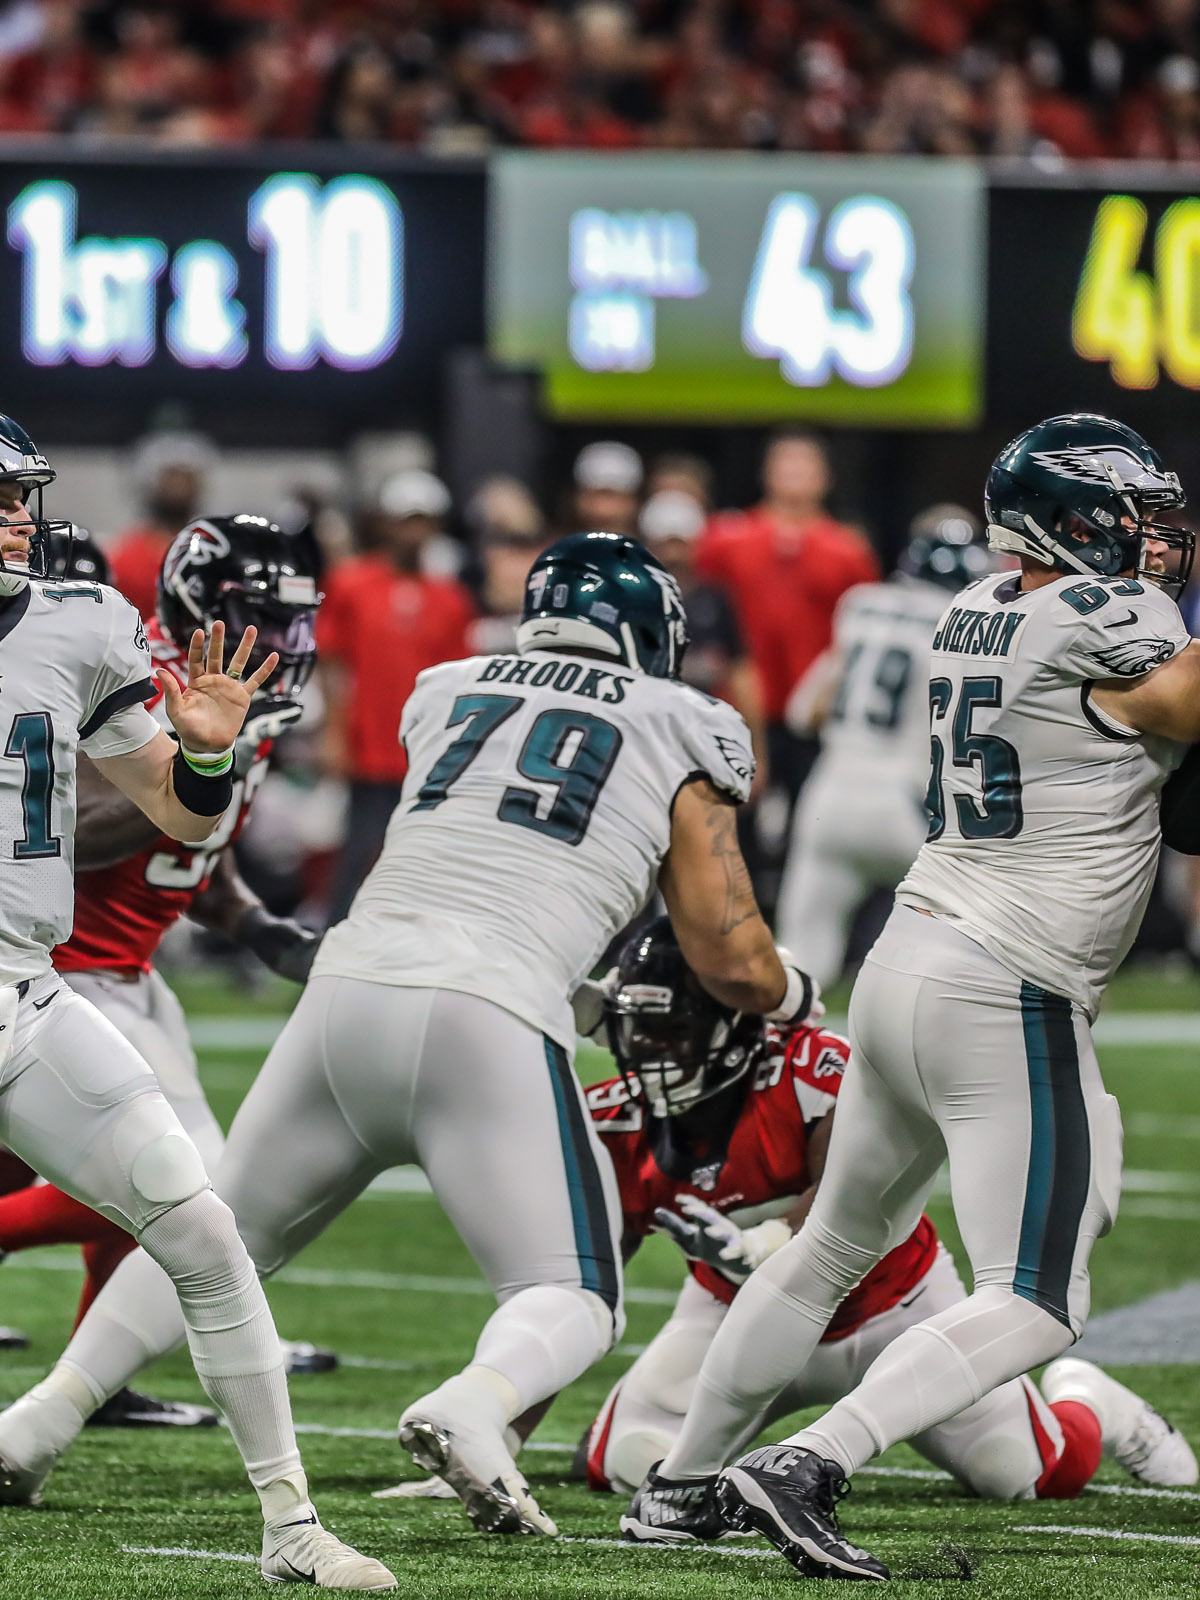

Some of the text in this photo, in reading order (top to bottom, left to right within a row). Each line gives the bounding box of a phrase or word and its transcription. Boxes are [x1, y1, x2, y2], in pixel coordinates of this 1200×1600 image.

[166, 239, 248, 368] &
[248, 172, 404, 371] 10
[742, 192, 915, 387] 43
[1071, 195, 1200, 390] 40
[476, 658, 635, 704] BROOKS
[932, 607, 1026, 656] JOHNSON
[407, 693, 623, 847] 79
